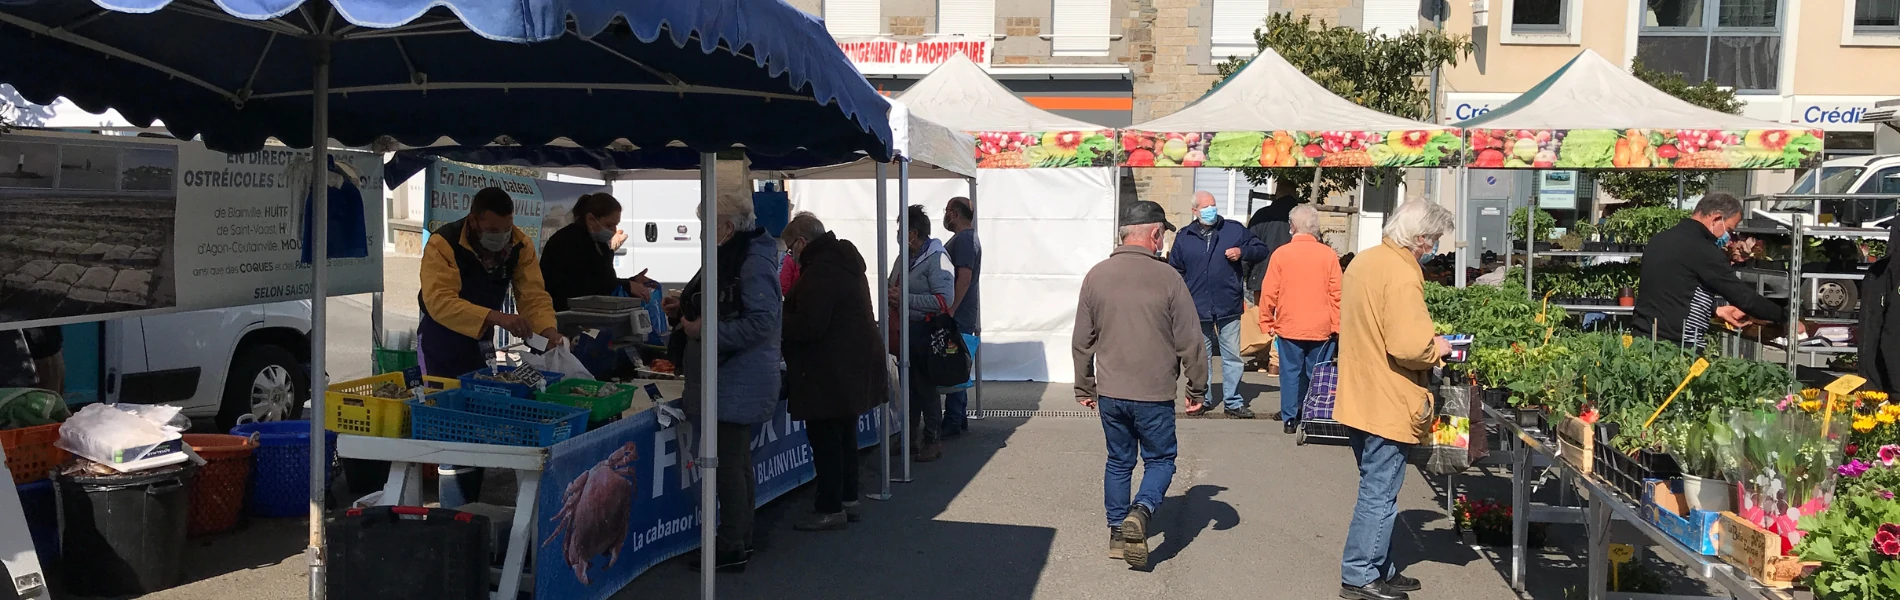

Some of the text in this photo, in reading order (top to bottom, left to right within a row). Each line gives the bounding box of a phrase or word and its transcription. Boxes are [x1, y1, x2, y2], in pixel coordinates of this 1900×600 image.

[900, 42, 912, 63] de
[1804, 105, 1868, 123] Crédi
[226, 151, 245, 164] EN
[249, 150, 293, 166] DIRECT
[183, 168, 275, 188] OSTRÉICOLES
[440, 166, 534, 195] En direct du bateau
[431, 190, 459, 210] BAIE
[214, 206, 226, 218] de
[216, 225, 229, 236] de
[225, 264, 239, 275] des
[239, 262, 274, 274] COQUES
[253, 282, 313, 300] SELON SAISO
[757, 443, 809, 485] BLAINVILLE
[633, 531, 644, 553] La
[645, 513, 694, 545] cabanor
